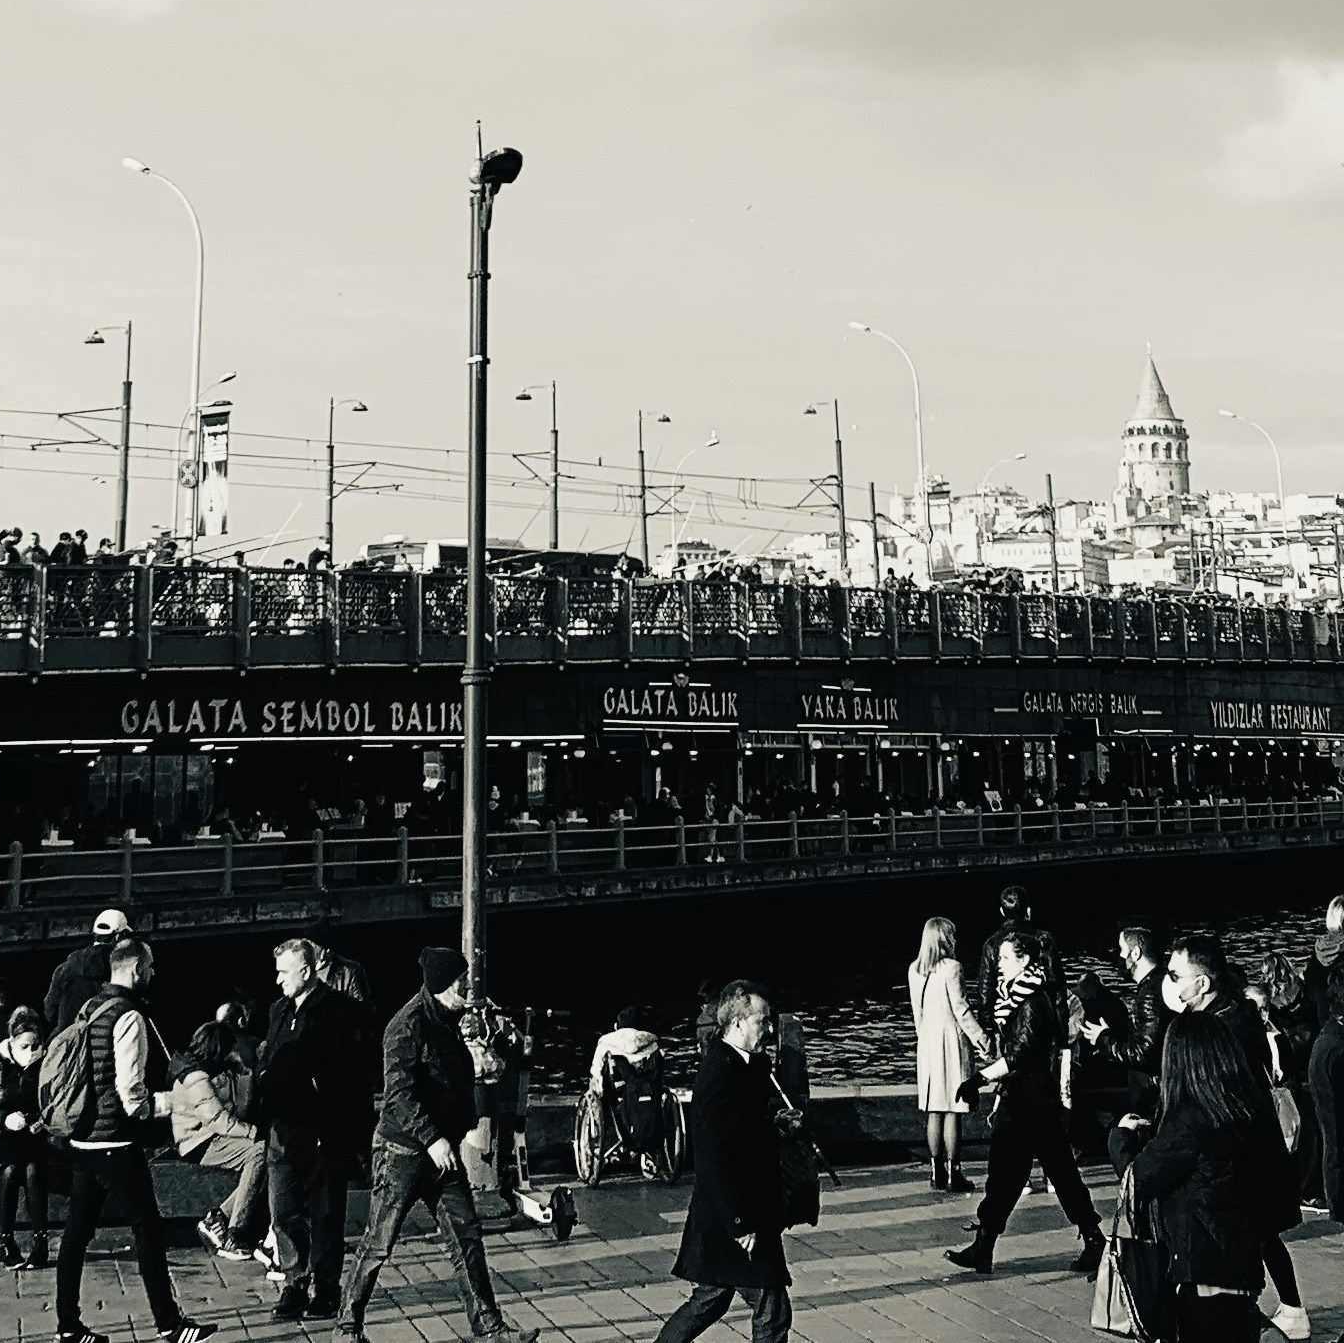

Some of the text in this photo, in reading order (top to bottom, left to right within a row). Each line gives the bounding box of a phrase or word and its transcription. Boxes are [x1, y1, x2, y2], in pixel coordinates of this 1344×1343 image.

[120, 698, 464, 735] GALATA SEMBOL BALIK
[603, 687, 738, 717] GALATA BALIK
[801, 694, 899, 722] YAKA BALIK
[1023, 691, 1064, 713] GALATA
[1111, 693, 1138, 715] BALIK
[1210, 701, 1331, 731] YILDIZLAR RESTAURANT
